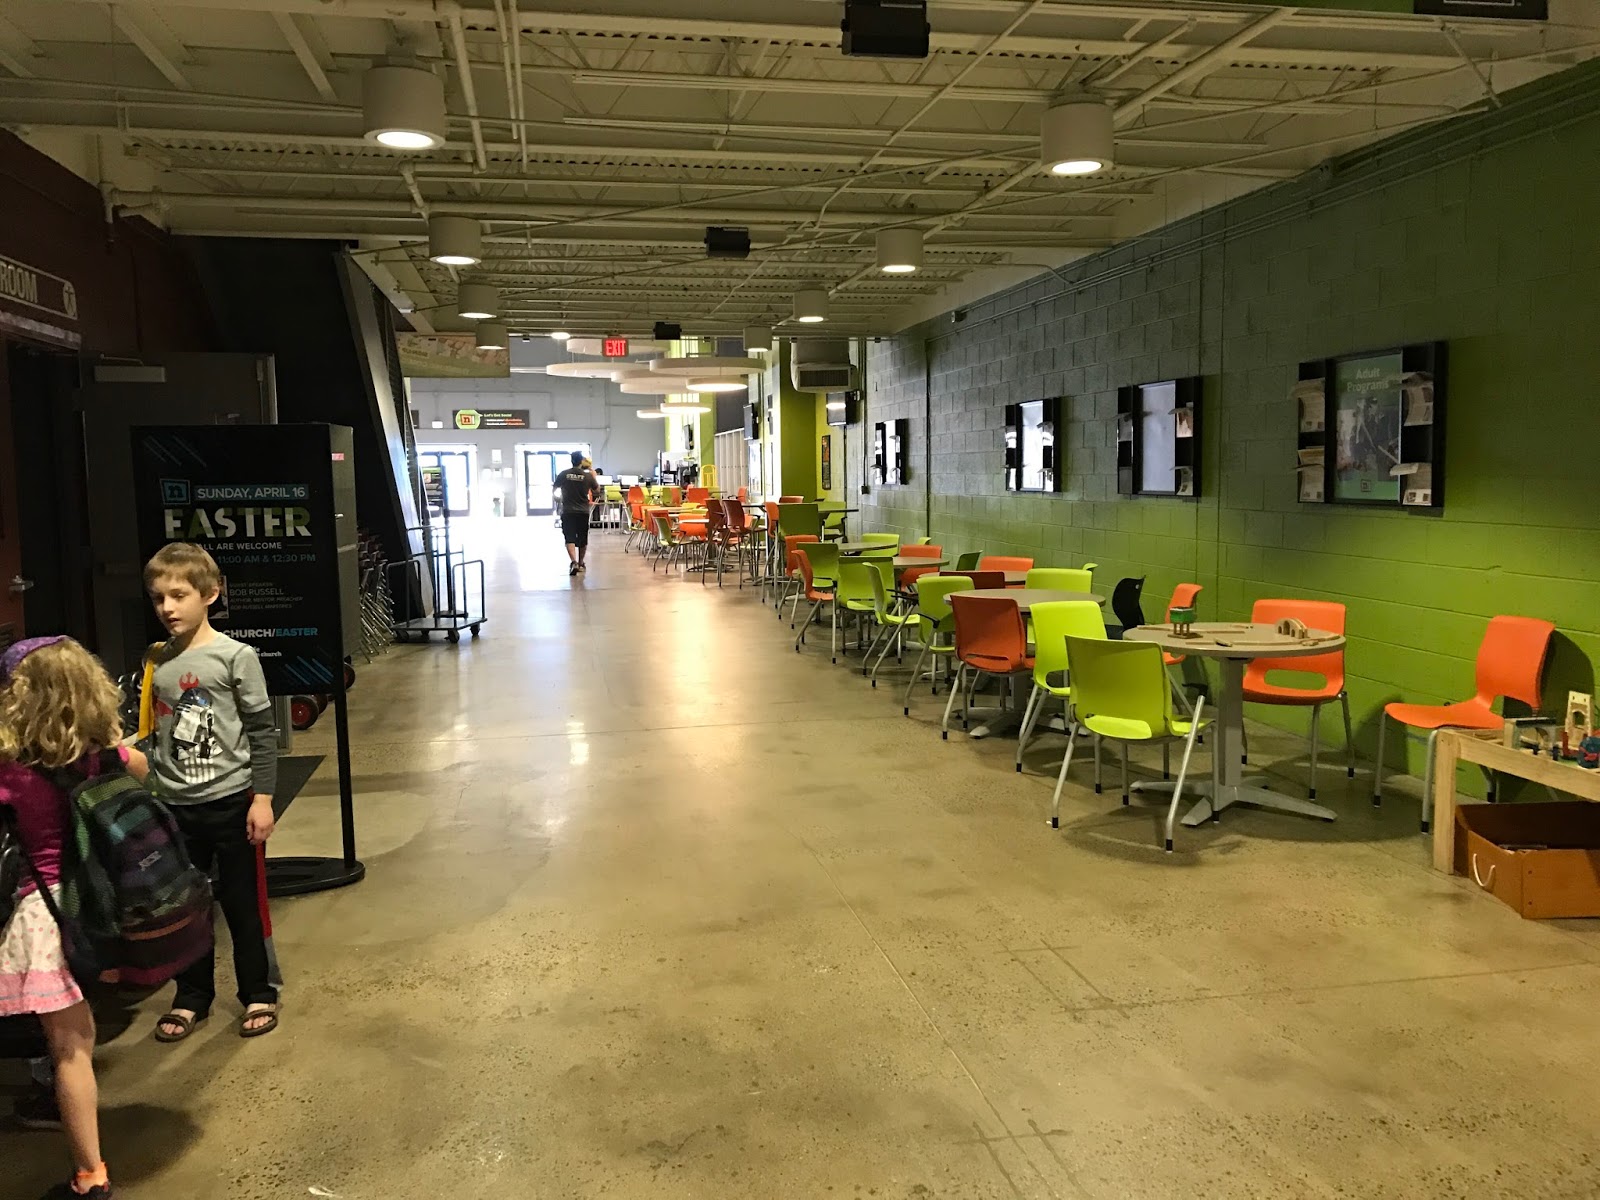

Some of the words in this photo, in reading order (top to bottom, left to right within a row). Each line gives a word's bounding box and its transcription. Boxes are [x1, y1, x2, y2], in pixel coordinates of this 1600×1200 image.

[605, 340, 626, 356] EXIT
[1355, 367, 1381, 380] Adult
[1346, 380, 1390, 394] Programs
[197, 487, 252, 500] SUNDAY,
[254, 487, 290, 498] APRIL
[292, 486, 306, 498] 16
[163, 506, 313, 540] EASTER
[216, 542, 234, 551] ARE
[235, 541, 282, 550] WELCOME
[217, 555, 242, 565] 11:00
[244, 555, 260, 564] AM
[263, 555, 270, 564] &
[272, 554, 298, 563] 12:30
[300, 553, 316, 562] PM
[229, 588, 247, 596] BOB
[248, 587, 284, 596] RUSSELL
